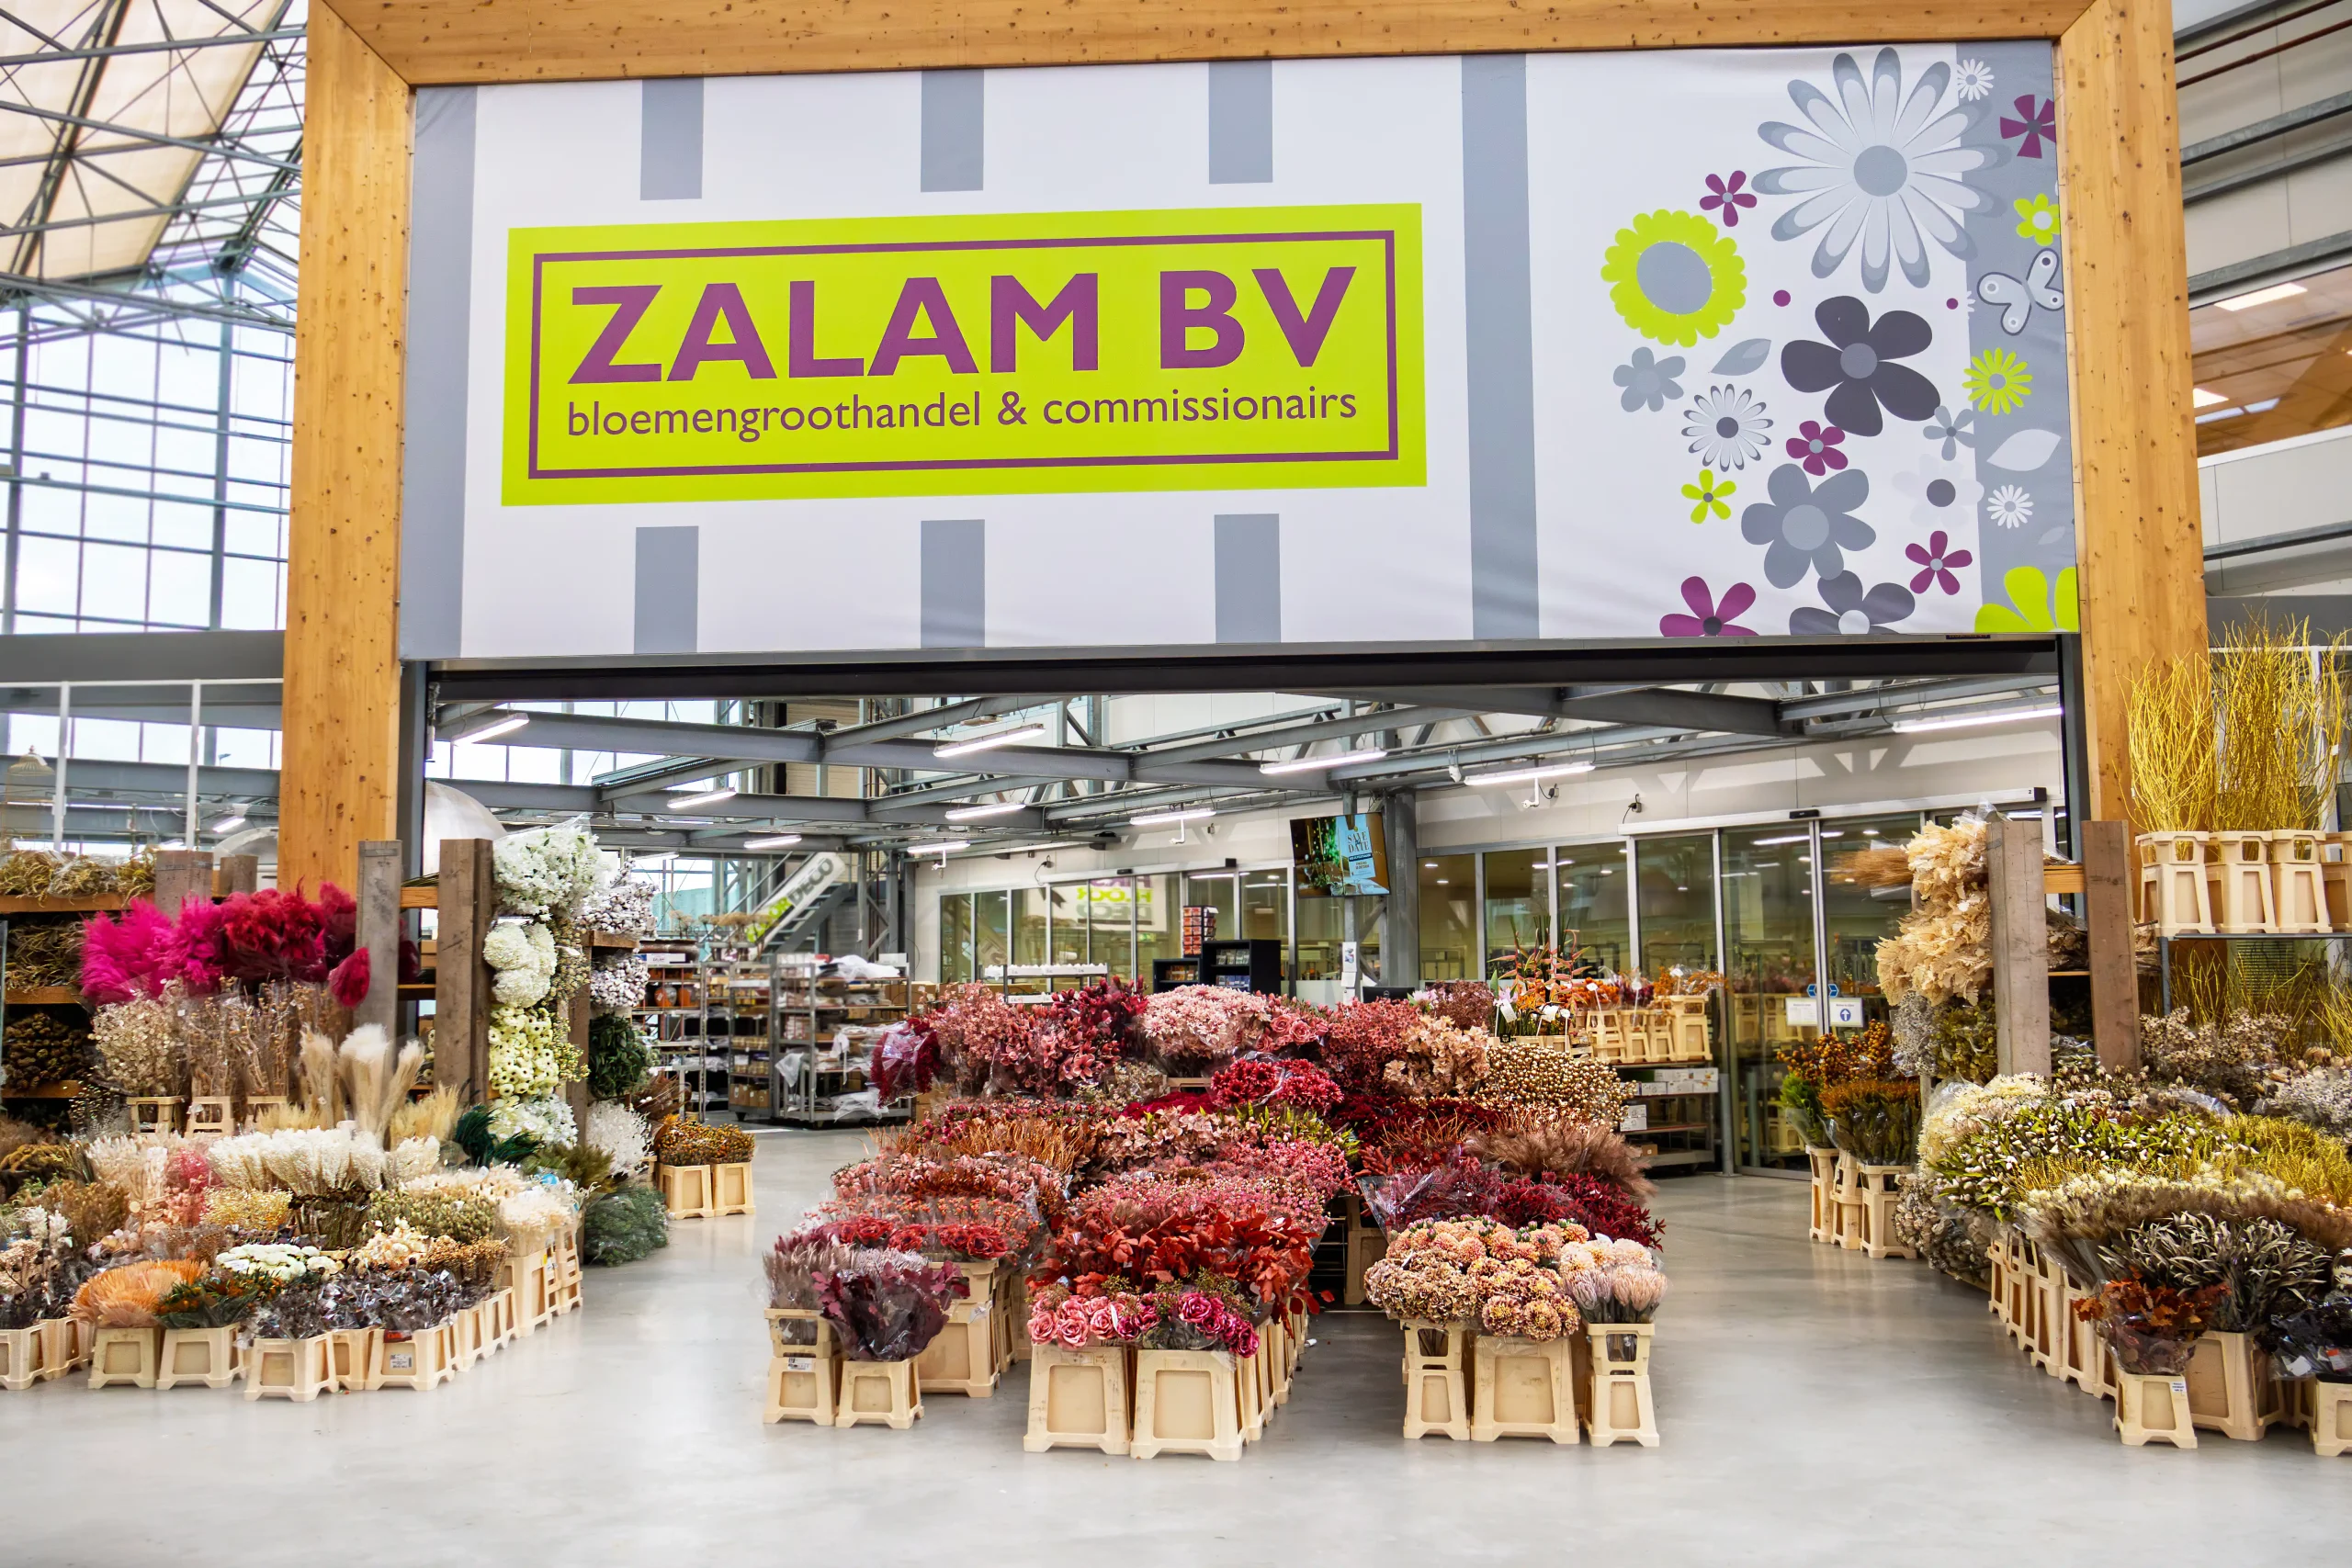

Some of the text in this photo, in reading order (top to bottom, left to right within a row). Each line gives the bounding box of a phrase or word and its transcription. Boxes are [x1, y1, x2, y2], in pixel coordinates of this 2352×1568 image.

[567, 266, 1357, 384] ZALAM BV
[568, 385, 1357, 443] bloemengroothandel & commissionairs
[1347, 831, 1368, 842] SAVE
[1348, 841, 1370, 852] DATE
[787, 858, 833, 907] DECO
